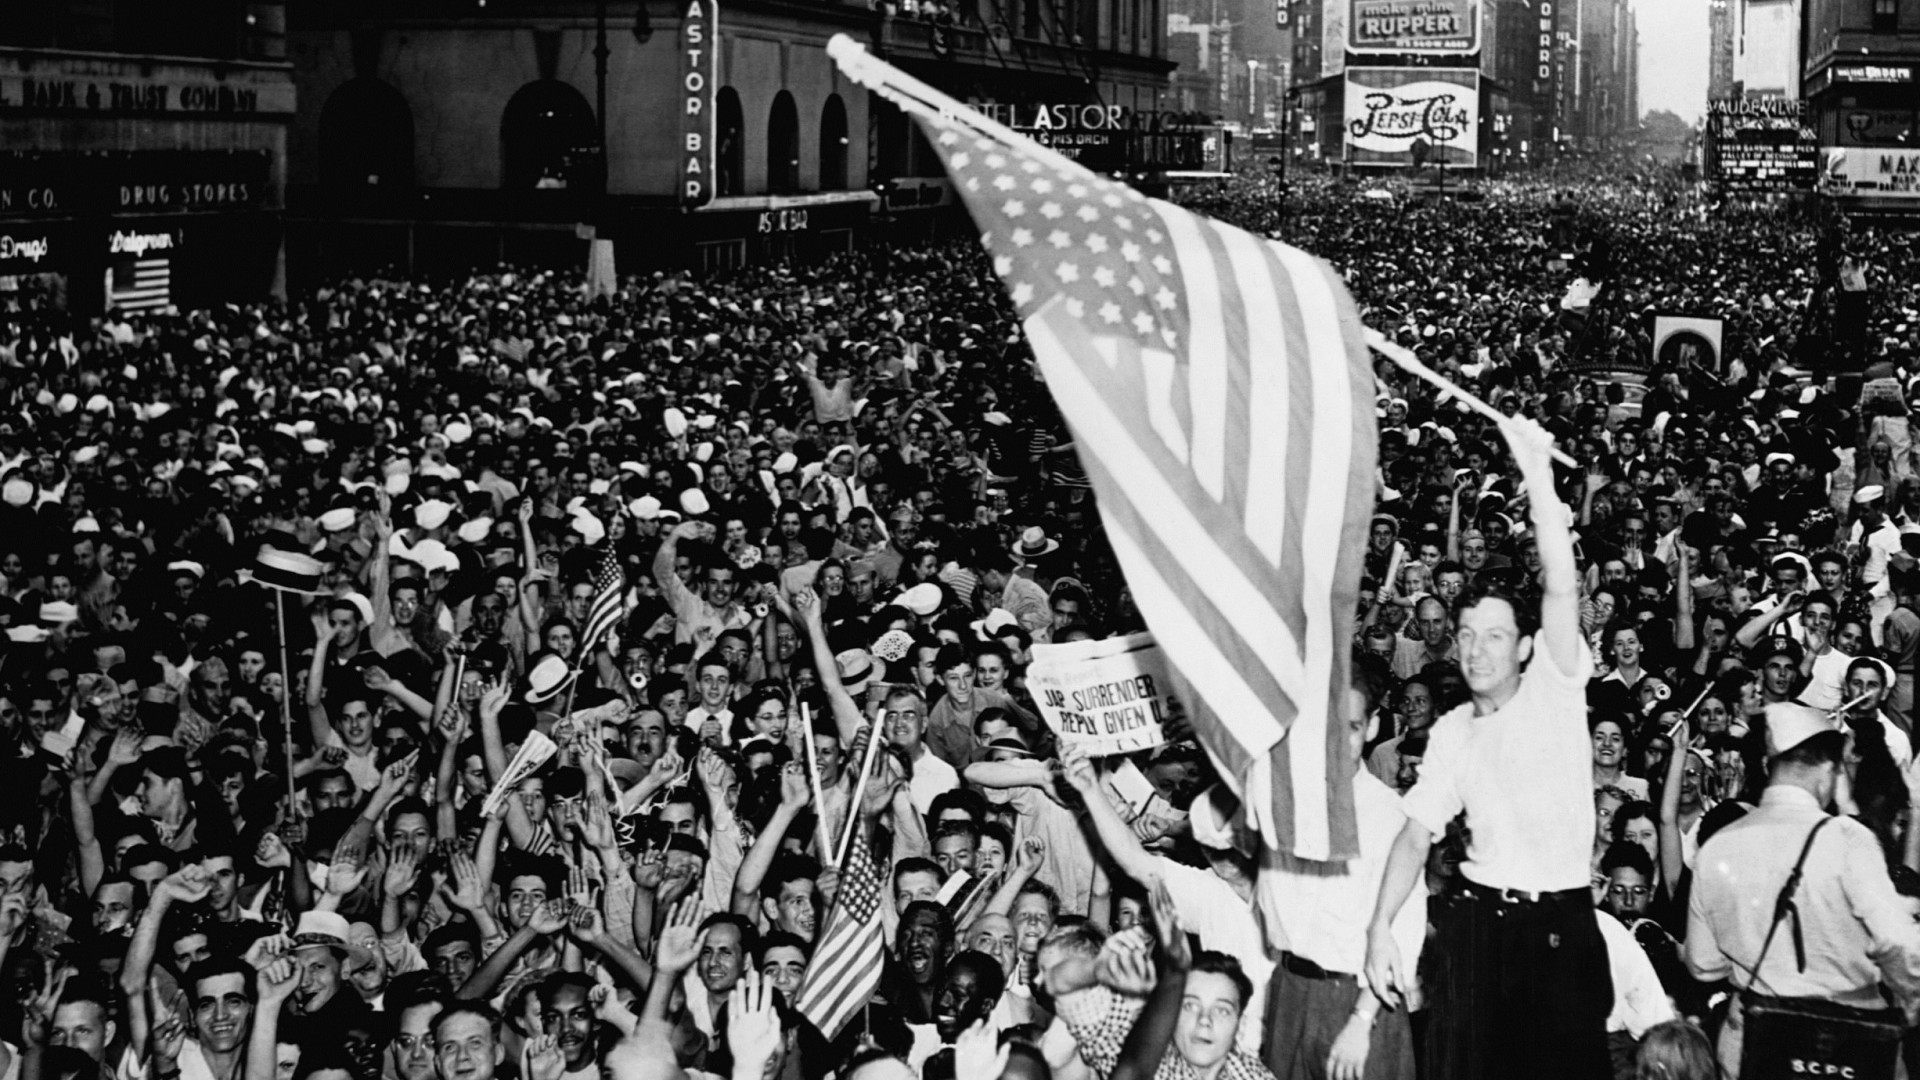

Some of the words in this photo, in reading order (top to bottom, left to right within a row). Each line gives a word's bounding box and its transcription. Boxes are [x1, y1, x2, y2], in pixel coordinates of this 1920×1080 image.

[1365, 0, 1409, 15] make
[1416, 0, 1455, 13] mine
[1366, 14, 1462, 35] RUPPERT
[685, 0, 703, 115] ASTOR
[23, 79, 77, 108] BANK
[86, 83, 101, 109] &
[110, 82, 167, 111] TRUST
[180, 86, 257, 113] COMPANY
[1707, 98, 1805, 116] VAUDEVILLE
[1034, 104, 1123, 130] ASTOR
[1052, 133, 1073, 145] HIS
[1076, 134, 1109, 146] ORCH
[686, 133, 703, 198] BAR
[27, 187, 59, 208] CO.
[120, 184, 170, 206] DRUG
[182, 182, 249, 203] STORES
[789, 208, 808, 231] BAR
[0, 235, 48, 263] Drugs
[1045, 689, 1065, 708] JAP
[1072, 674, 1157, 711] SURRENDER
[1059, 711, 1098, 735] REPLY
[1103, 705, 1147, 734] GIVEN
